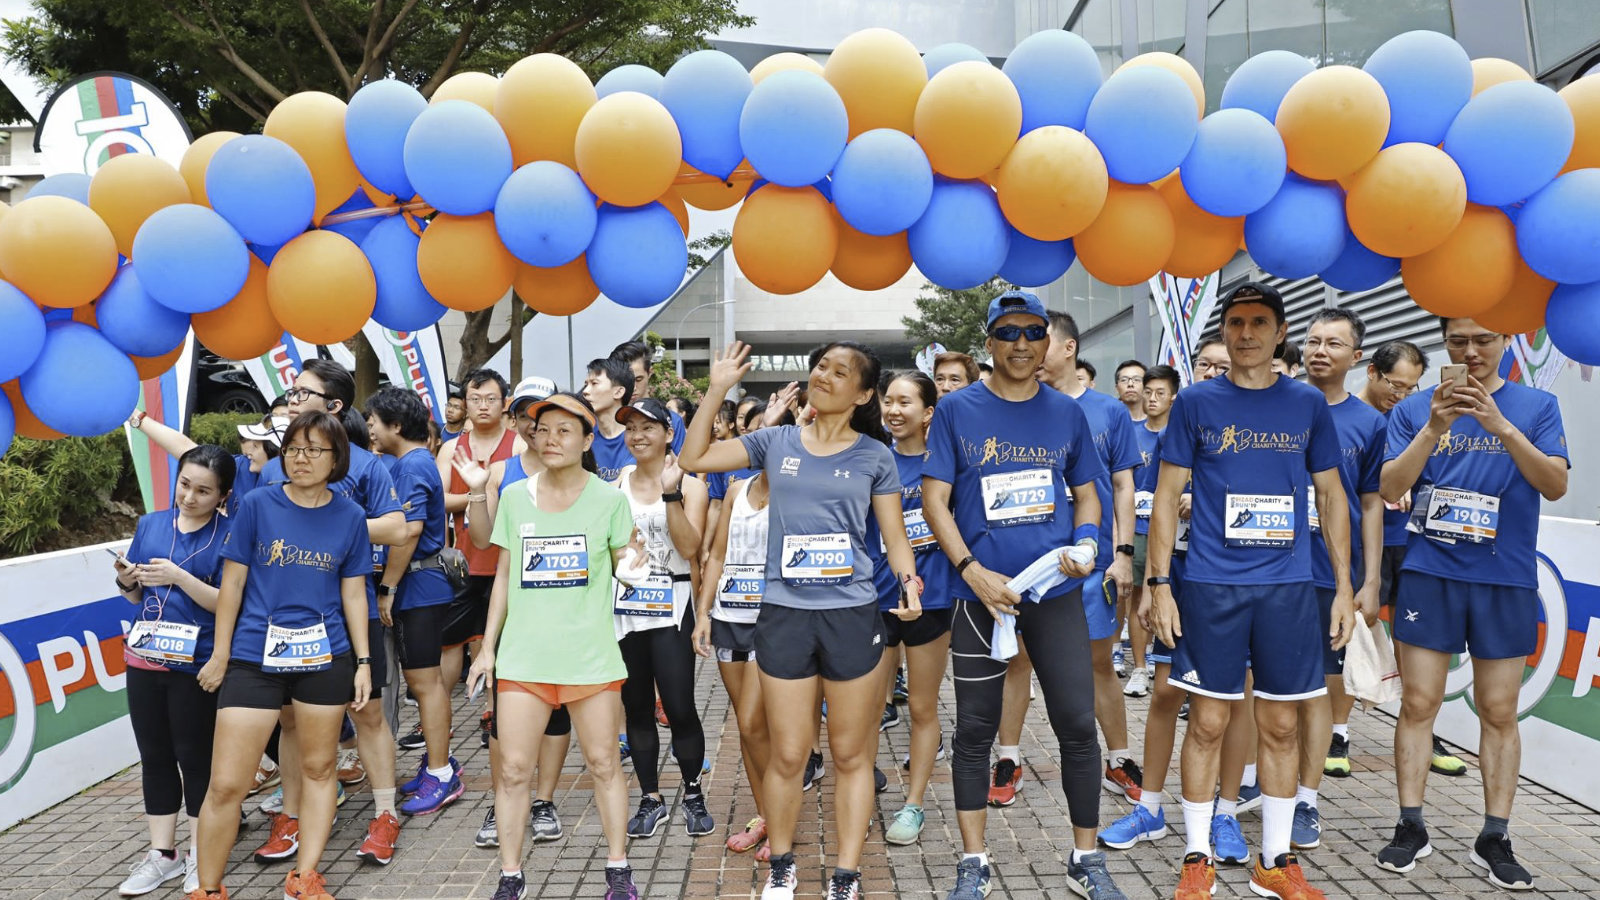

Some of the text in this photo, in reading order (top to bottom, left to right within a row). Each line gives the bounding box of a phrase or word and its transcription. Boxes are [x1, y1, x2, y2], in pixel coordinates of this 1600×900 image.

[1237, 428, 1290, 451] BIZAD
[1451, 433, 1501, 454] BIZAD
[998, 441, 1048, 463] BIZAD
[1009, 473, 1036, 482] CHARITY
[1012, 489, 1046, 504] 1729
[1454, 493, 1483, 503] CHARY
[1255, 514, 1288, 527] 1594
[1453, 508, 1491, 525] 1906
[905, 523, 930, 538] 095
[282, 544, 332, 565] BIZAD
[809, 552, 846, 565] 1990
[544, 555, 580, 569] 1702
[736, 581, 760, 592] 1615
[637, 590, 665, 601] 1479
[157, 623, 182, 631] CHARITY
[289, 628, 316, 637] CHARITY
[154, 637, 185, 652] 1018
[291, 642, 321, 656] 1139
